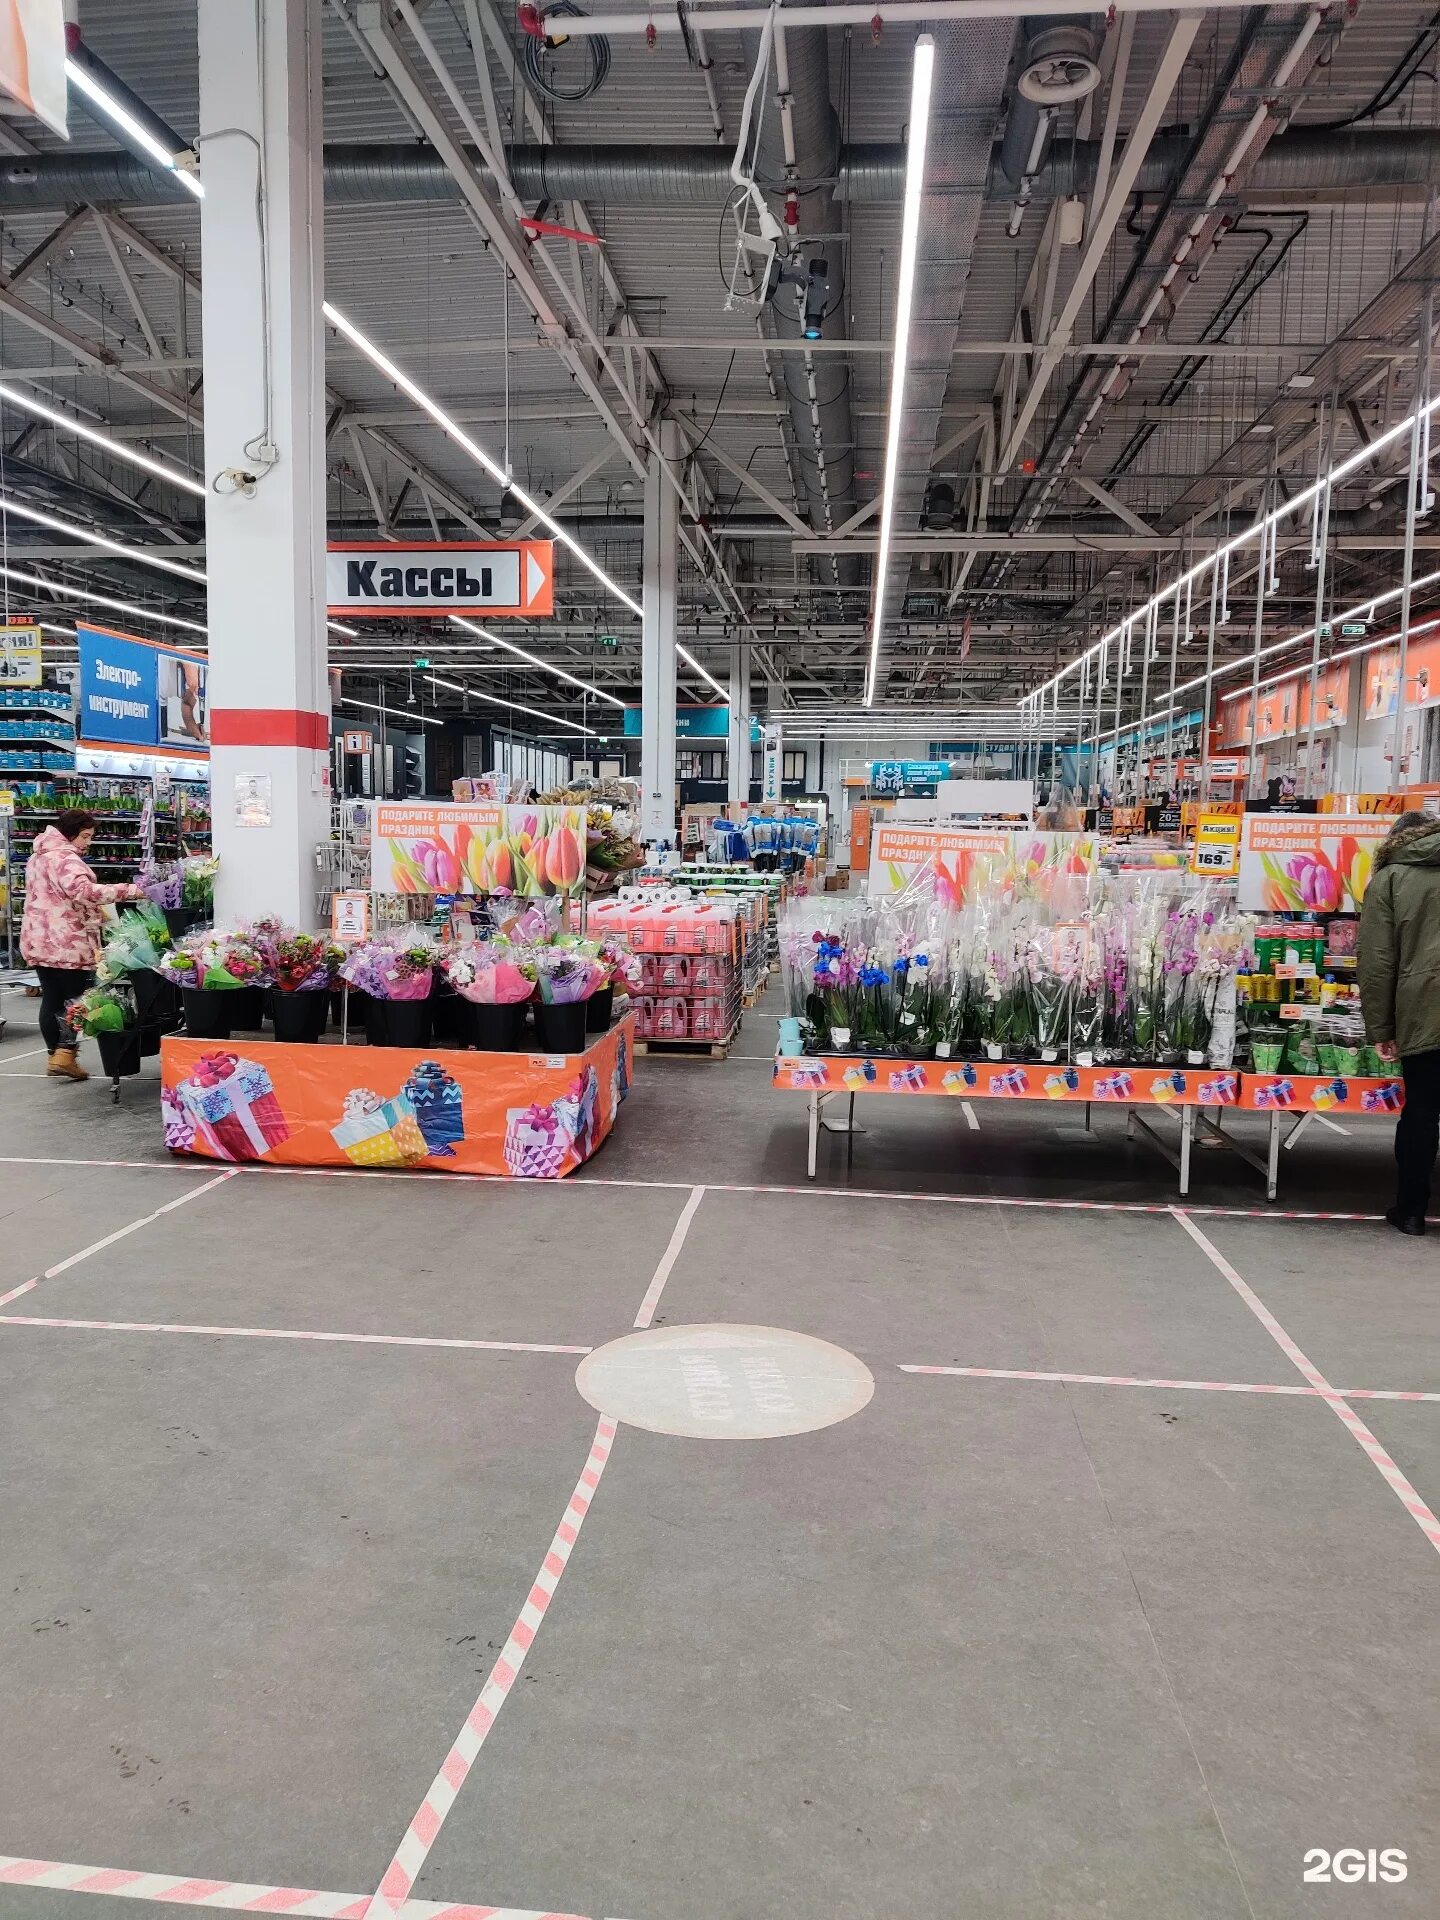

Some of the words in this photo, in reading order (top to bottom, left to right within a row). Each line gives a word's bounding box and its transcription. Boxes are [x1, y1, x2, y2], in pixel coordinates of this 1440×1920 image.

[347, 560, 492, 598] Кассы
[95, 658, 142, 690] Электро-
[88, 694, 150, 720] инструмент
[381, 810, 434, 822] ПОДАРИТЕ
[437, 811, 499, 823] ЛЮБИМЫМ
[380, 824, 436, 836] ПРАЗДНИК
[1203, 825, 1235, 833] Акция!
[1253, 821, 1316, 834] ПОДАРИТЕ
[882, 833, 937, 847] ПОДАРИТЕ
[1252, 837, 1317, 850] ПРАЗДНИК
